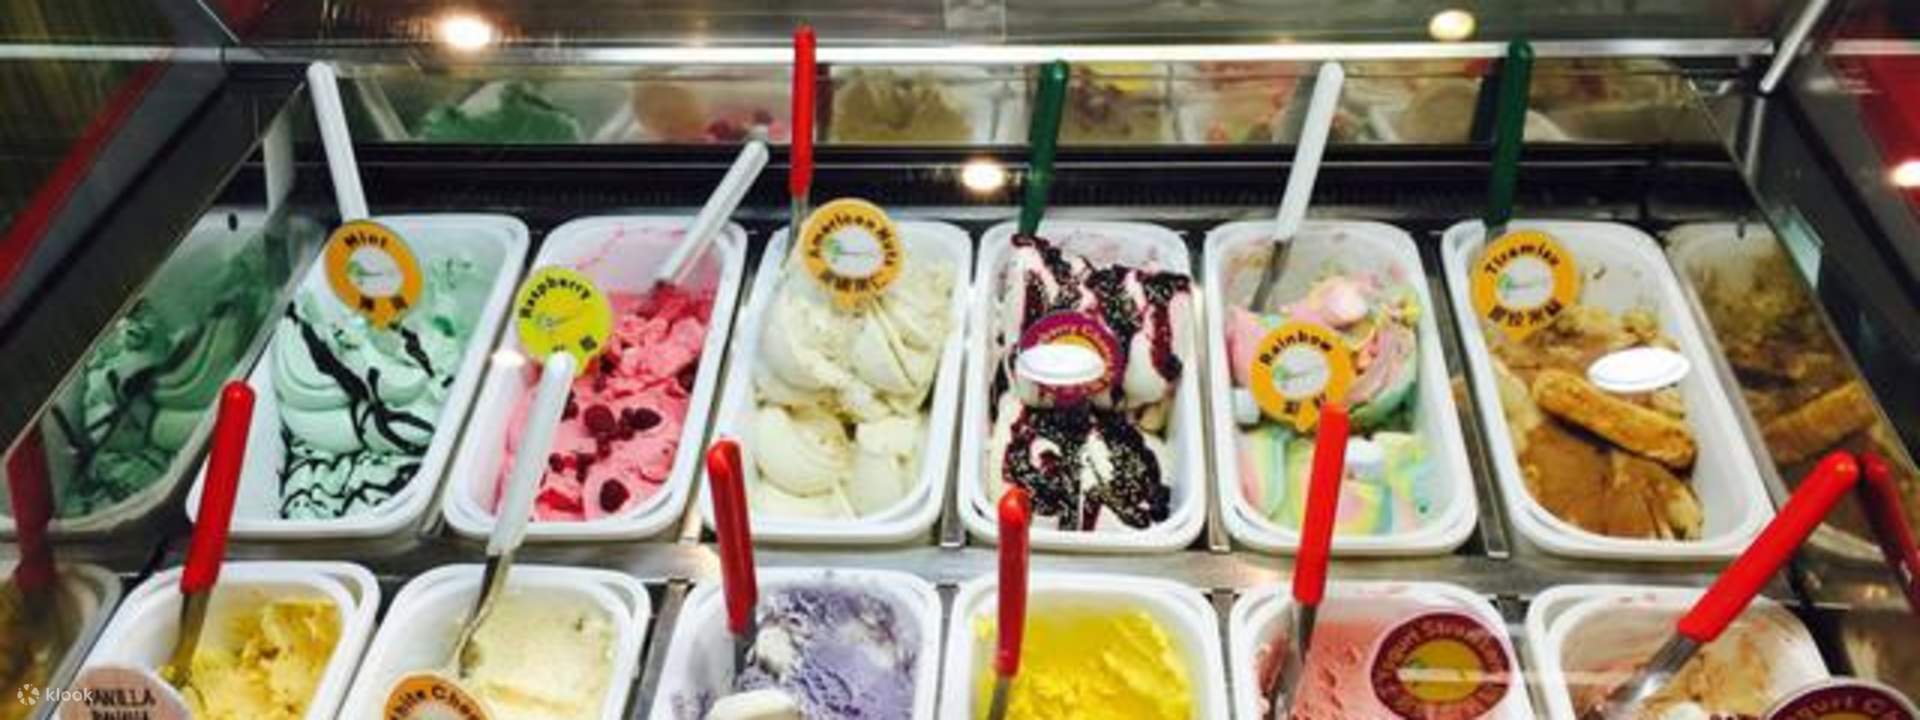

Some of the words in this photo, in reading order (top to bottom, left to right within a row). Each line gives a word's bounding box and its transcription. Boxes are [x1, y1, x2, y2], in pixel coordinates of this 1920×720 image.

[343, 231, 388, 249] Mint
[808, 212, 876, 258] American
[1484, 243, 1560, 275] Tiramisu
[519, 274, 590, 319] Raspberry
[1259, 328, 1332, 366] Rainbow
